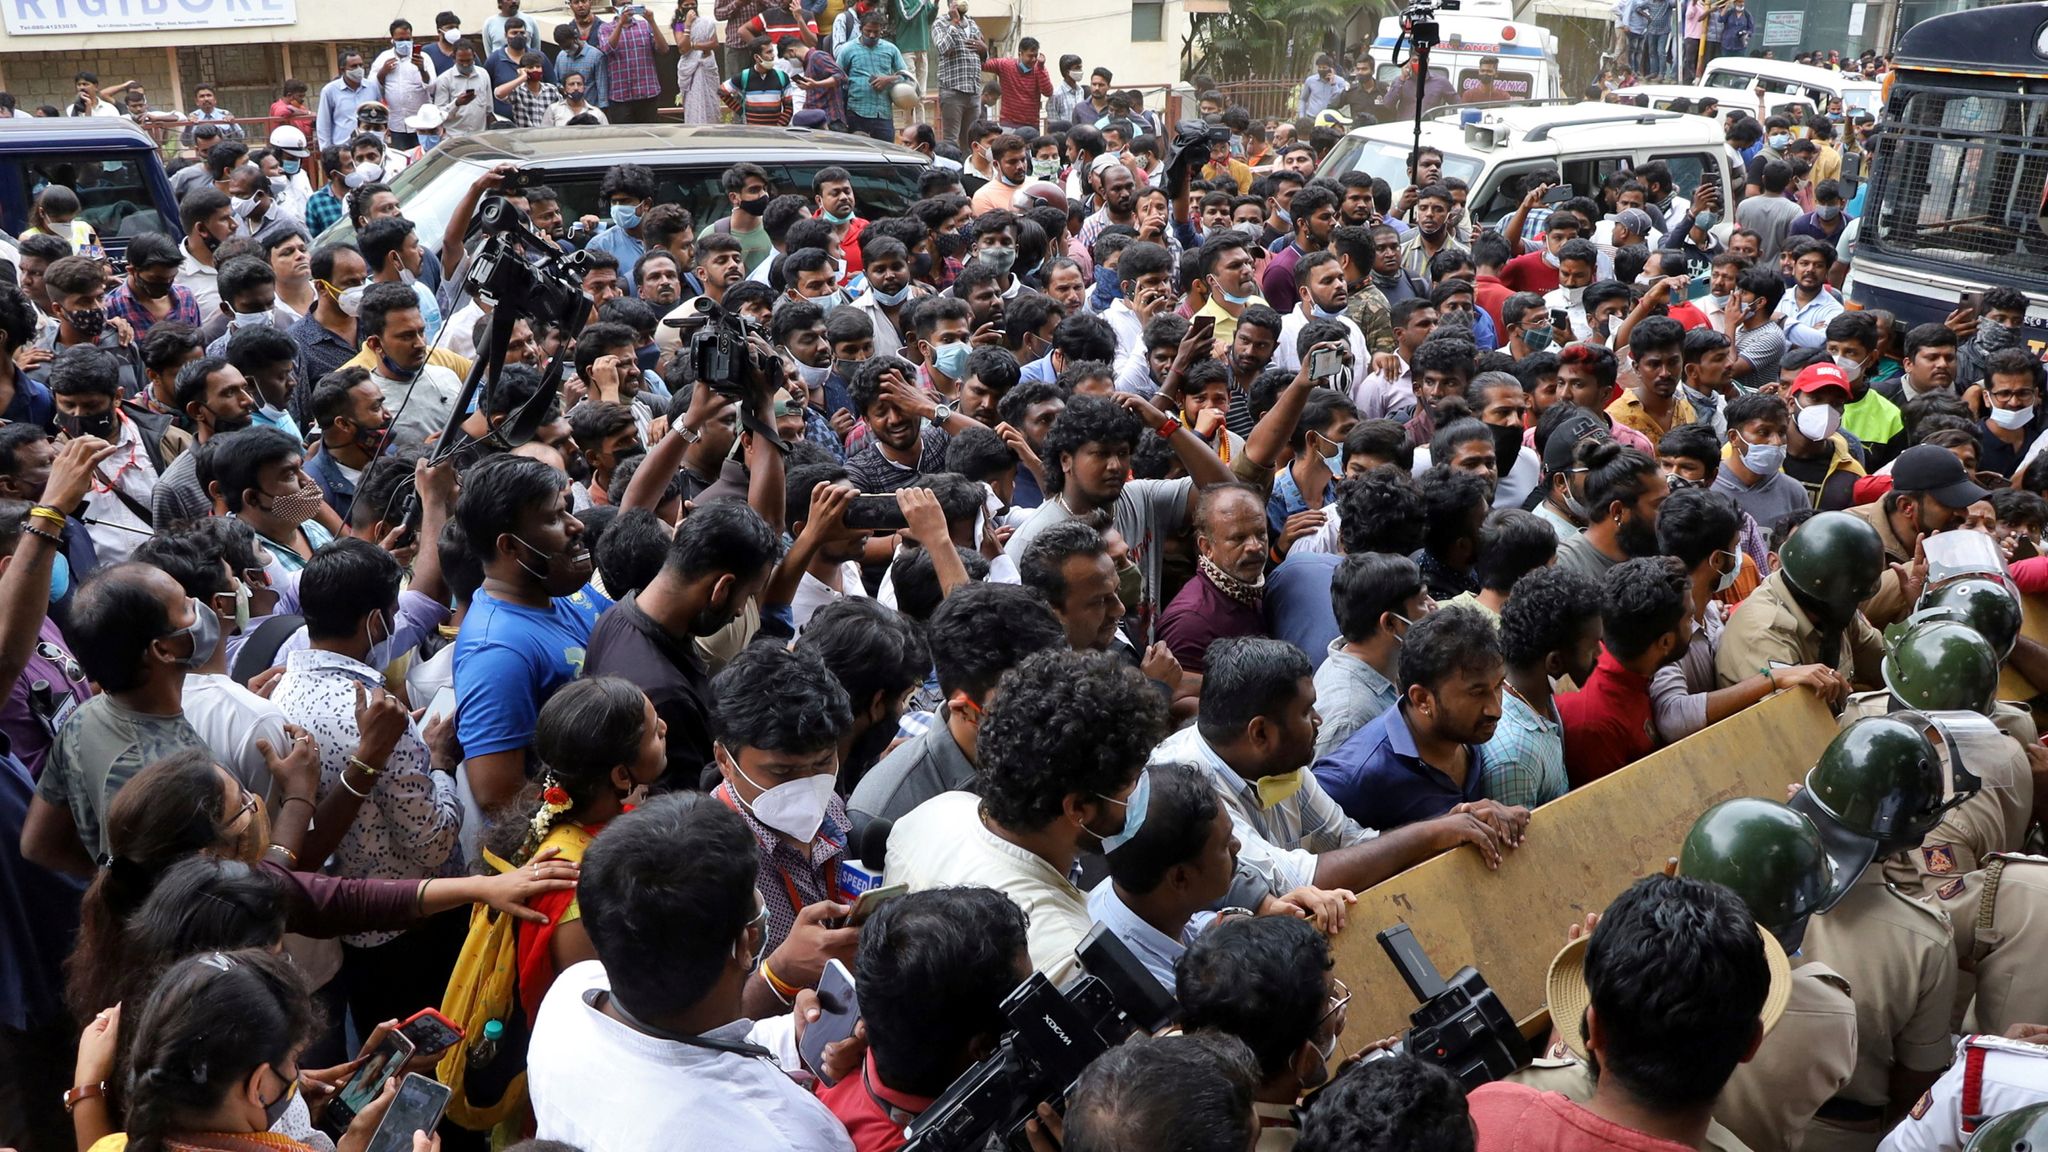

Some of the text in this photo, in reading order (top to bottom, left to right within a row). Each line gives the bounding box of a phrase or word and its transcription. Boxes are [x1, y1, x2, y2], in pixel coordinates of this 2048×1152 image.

[1434, 42, 1500, 53] BULANCE
[1463, 78, 1528, 93] CHHANYA
[842, 871, 868, 892] SPEED
[1042, 1014, 1072, 1046] XDCAM
